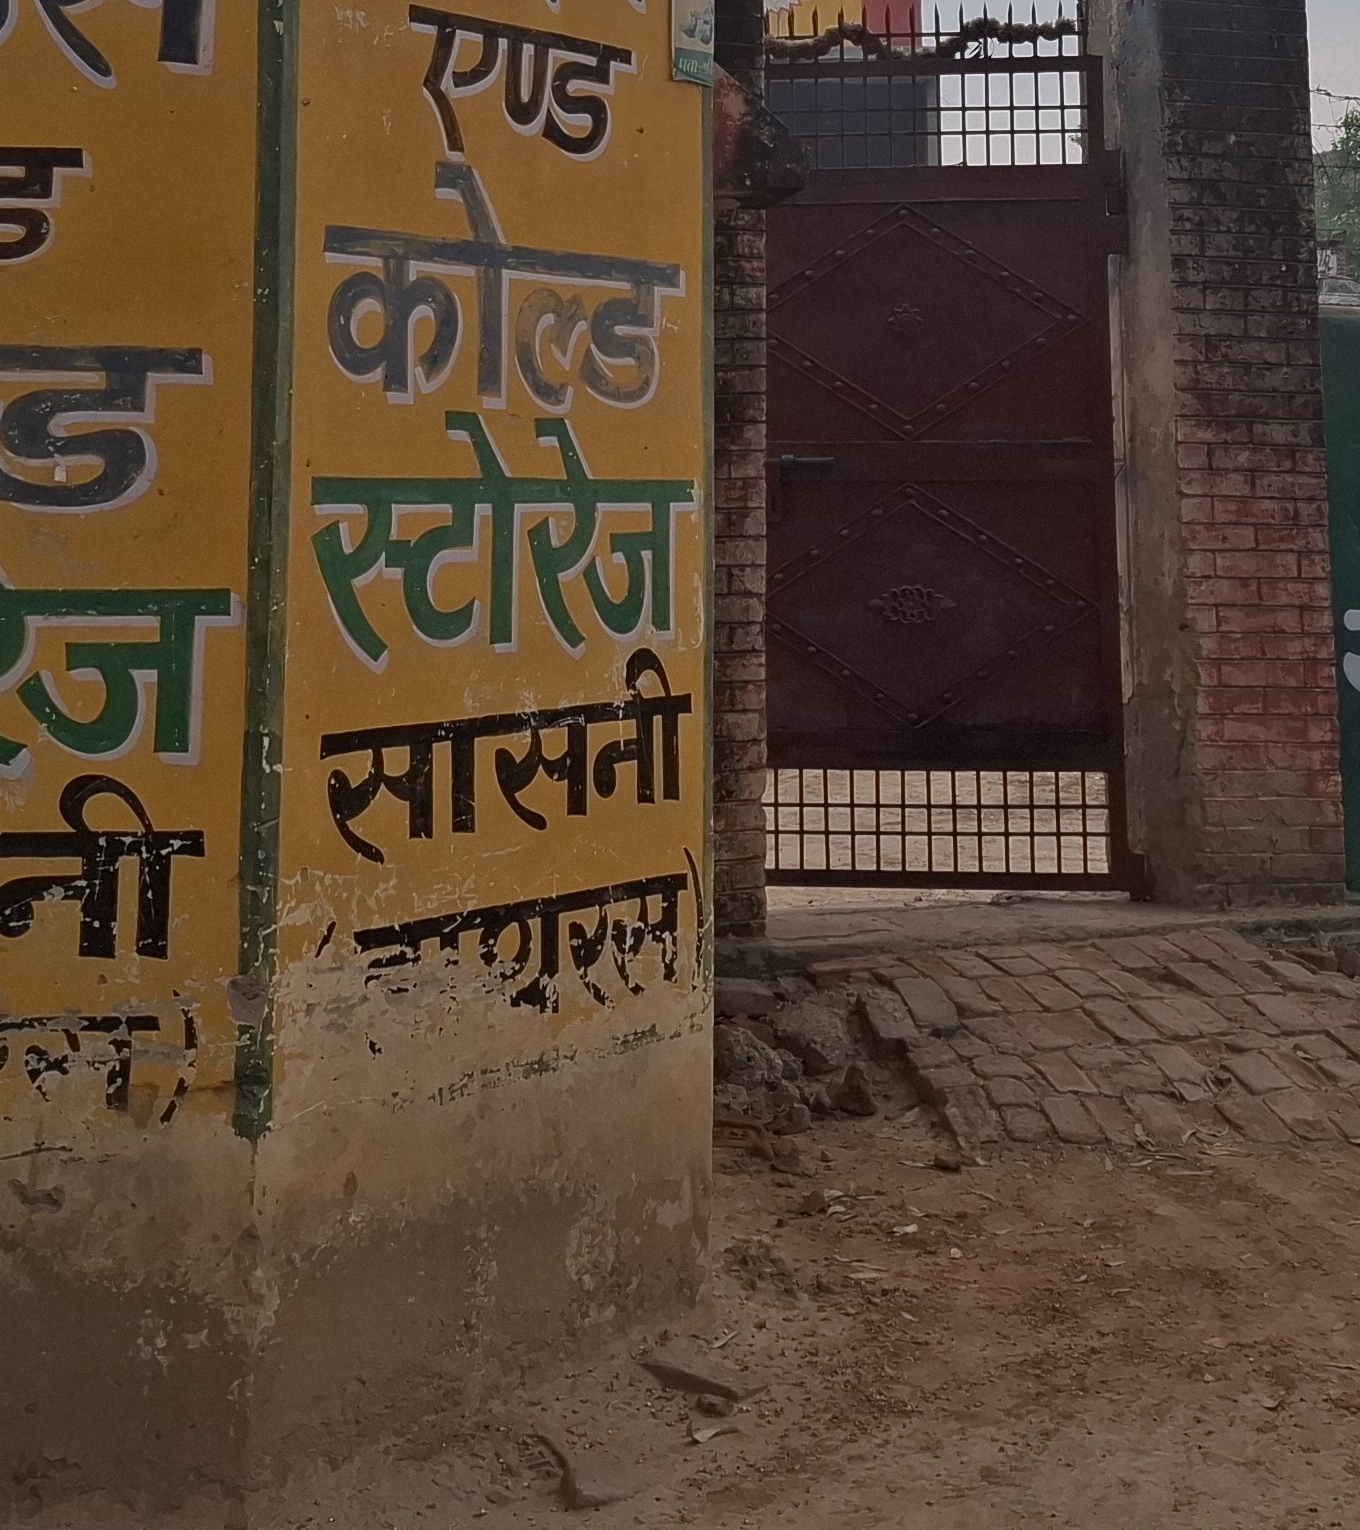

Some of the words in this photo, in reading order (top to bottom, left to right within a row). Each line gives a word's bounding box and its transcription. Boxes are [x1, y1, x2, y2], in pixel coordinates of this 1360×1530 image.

[408, 2, 637, 160] एण्ड
[324, 160, 686, 412] कोल्ड
[310, 410, 700, 671] स्टोरेज
[320, 647, 693, 865] सासनी
